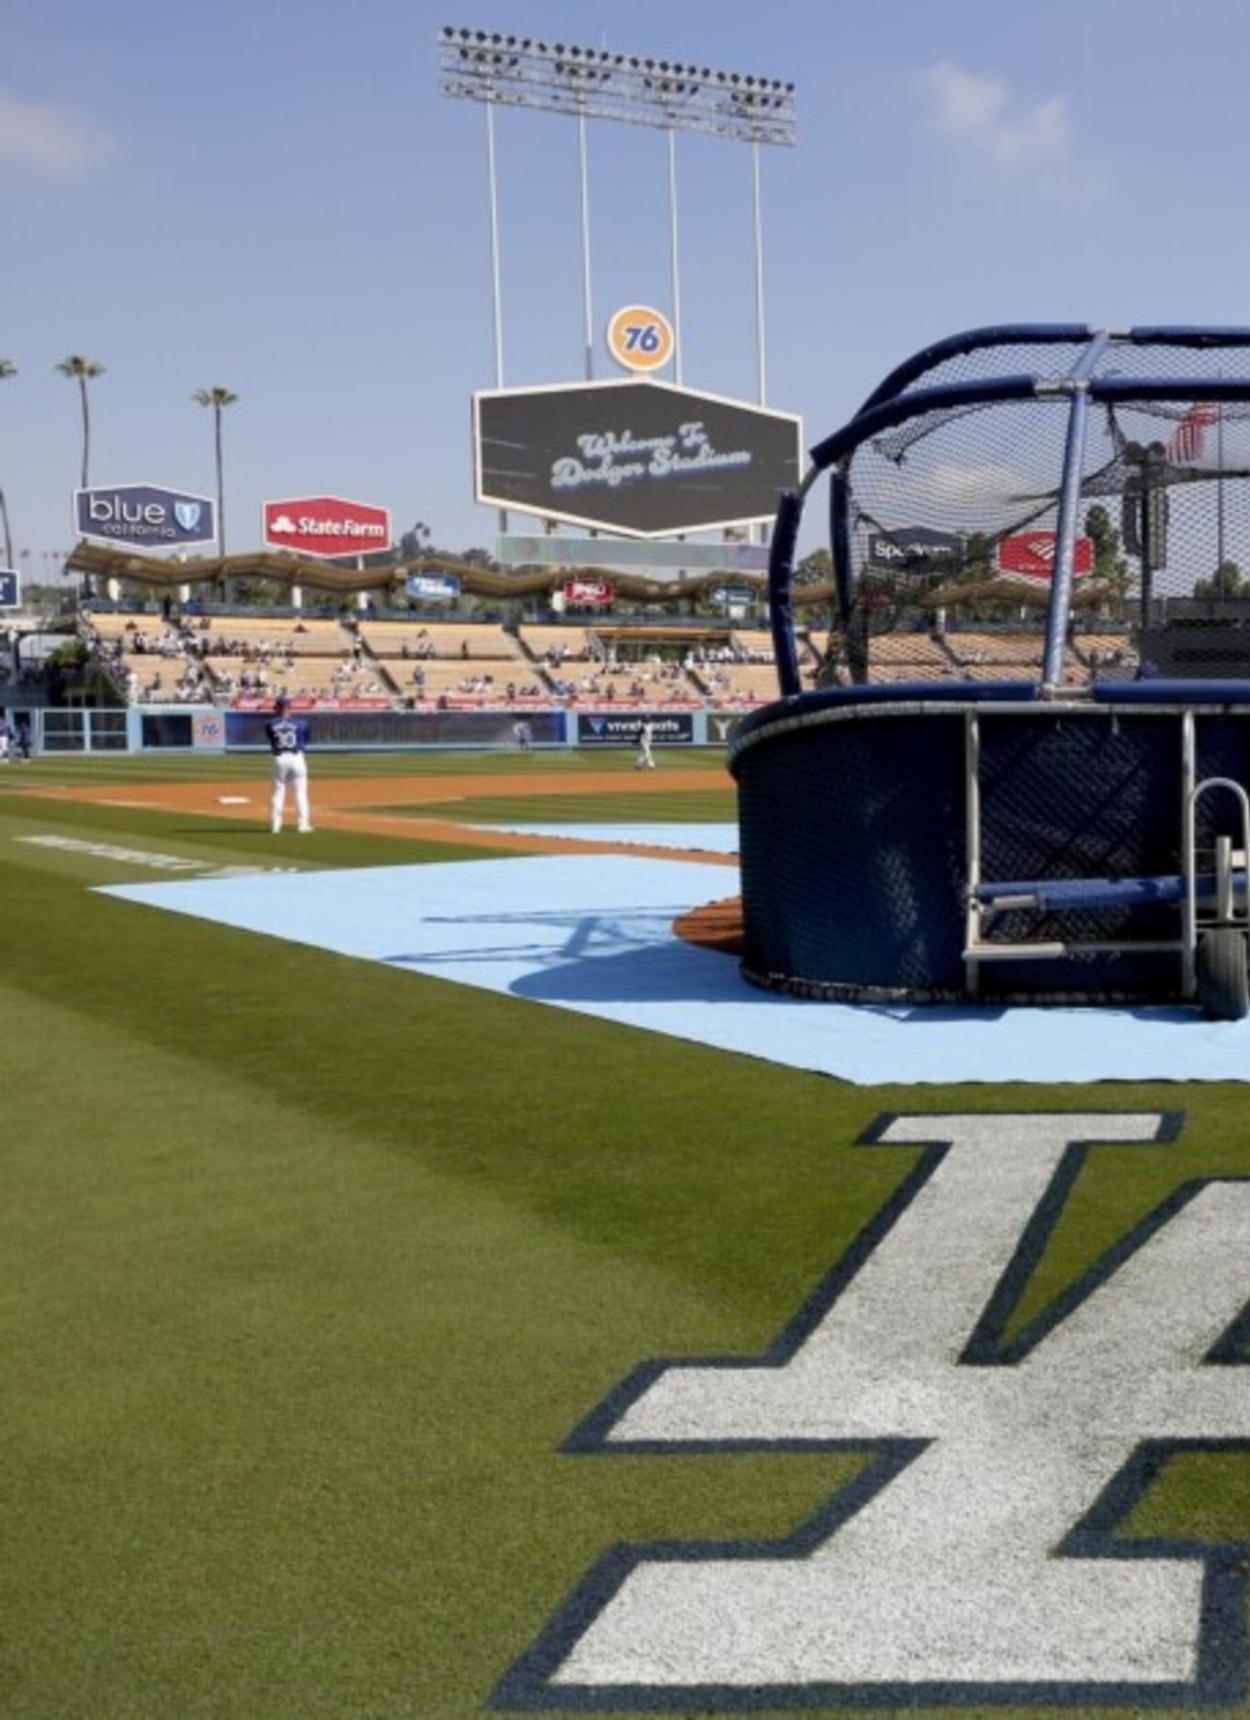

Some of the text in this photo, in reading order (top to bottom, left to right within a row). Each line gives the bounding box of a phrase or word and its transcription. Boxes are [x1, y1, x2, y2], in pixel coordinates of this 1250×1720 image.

[622, 325, 660, 352] 76
[577, 421, 707, 458] Welcome To
[551, 443, 751, 486] Dodger Stadium
[89, 493, 166, 524] blue
